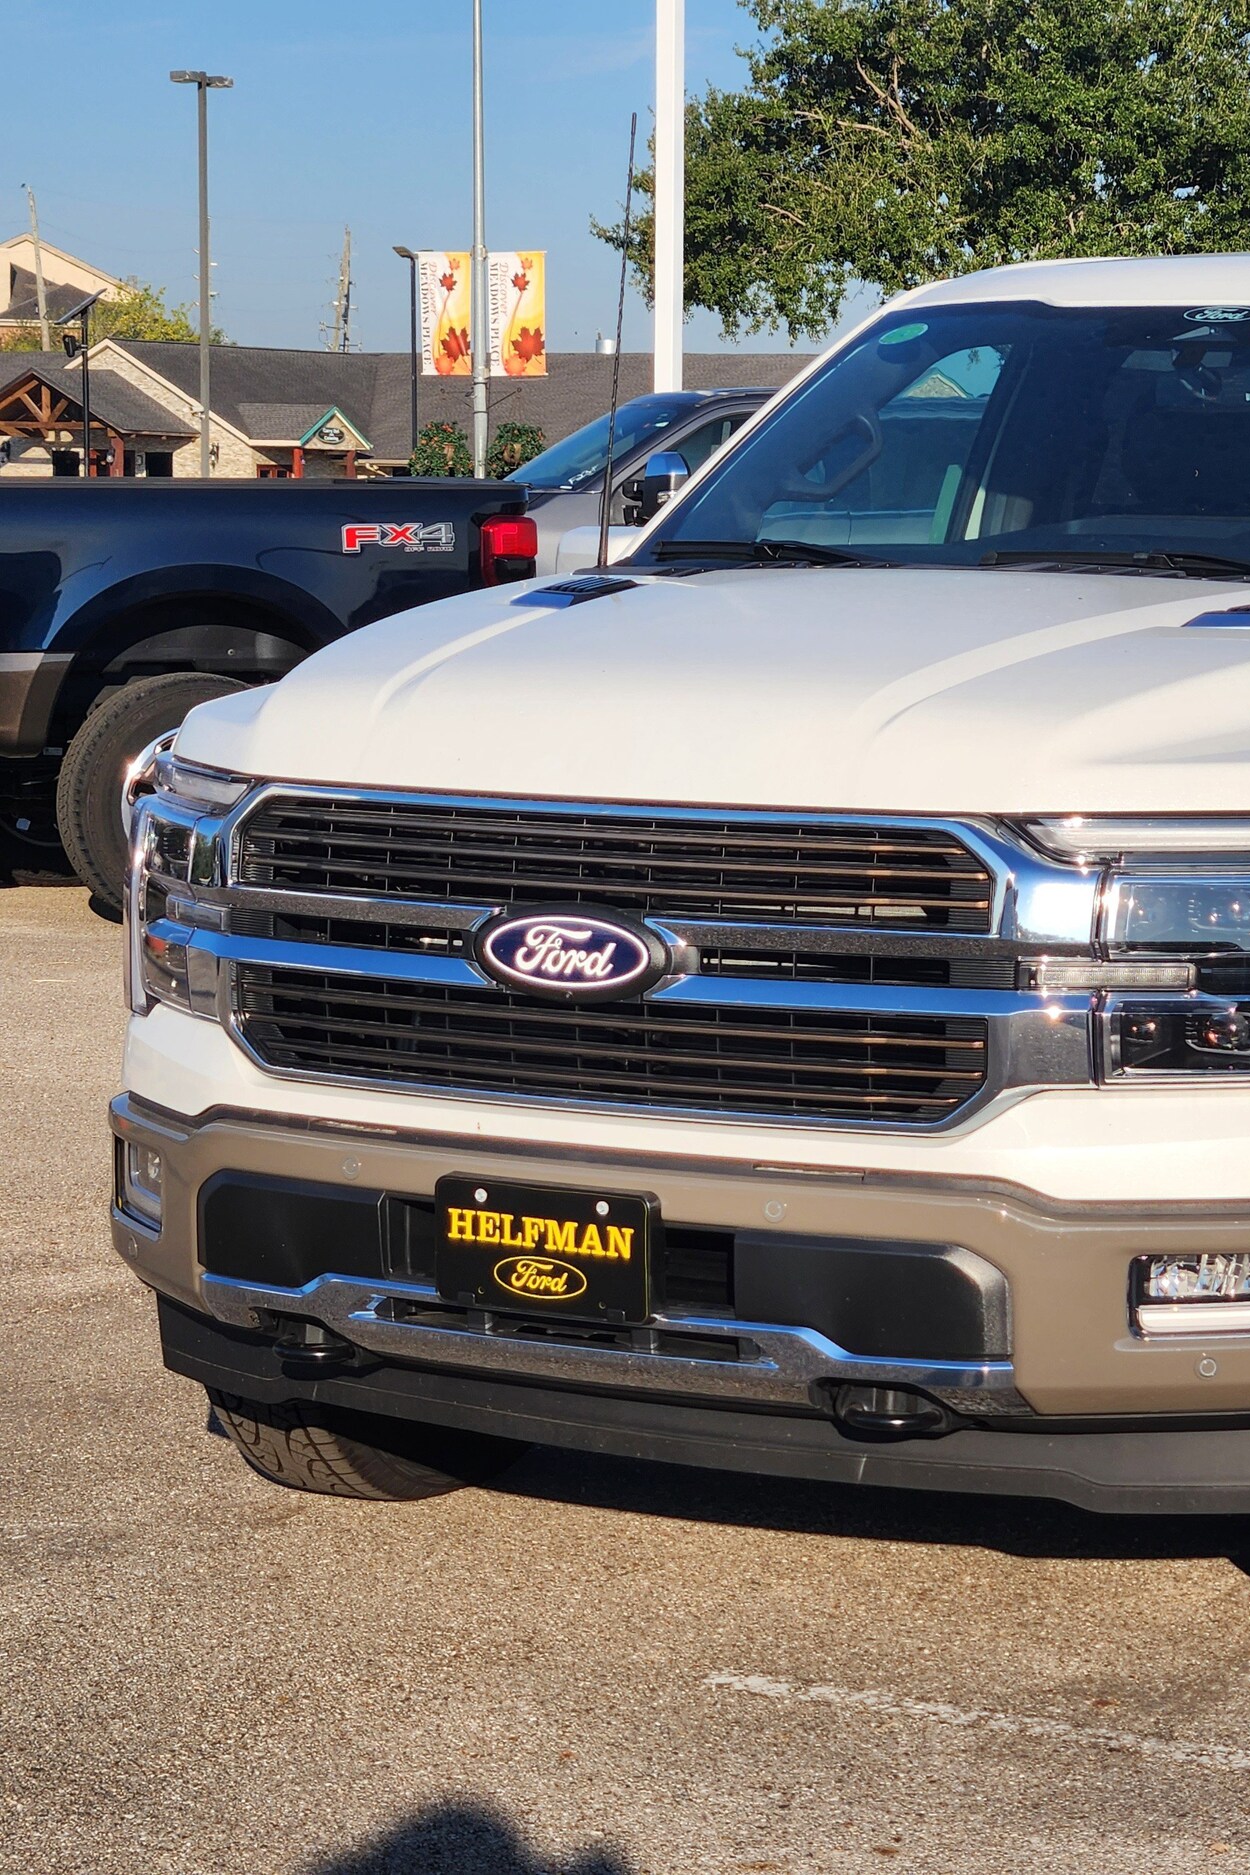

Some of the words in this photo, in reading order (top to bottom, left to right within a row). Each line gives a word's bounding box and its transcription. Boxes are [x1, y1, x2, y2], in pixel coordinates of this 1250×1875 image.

[420, 262, 430, 324] MEADOWS
[429, 261, 438, 317] Discover
[490, 262, 500, 325] MEADOWS
[499, 262, 509, 317] Discover
[1194, 308, 1249, 320] Ford
[422, 326, 432, 366] PLACE
[490, 327, 500, 367] PLACE
[341, 522, 455, 553] FX4
[516, 925, 617, 976] Ford
[447, 1207, 634, 1260] HELFMAN
[511, 1259, 568, 1292] Ford
